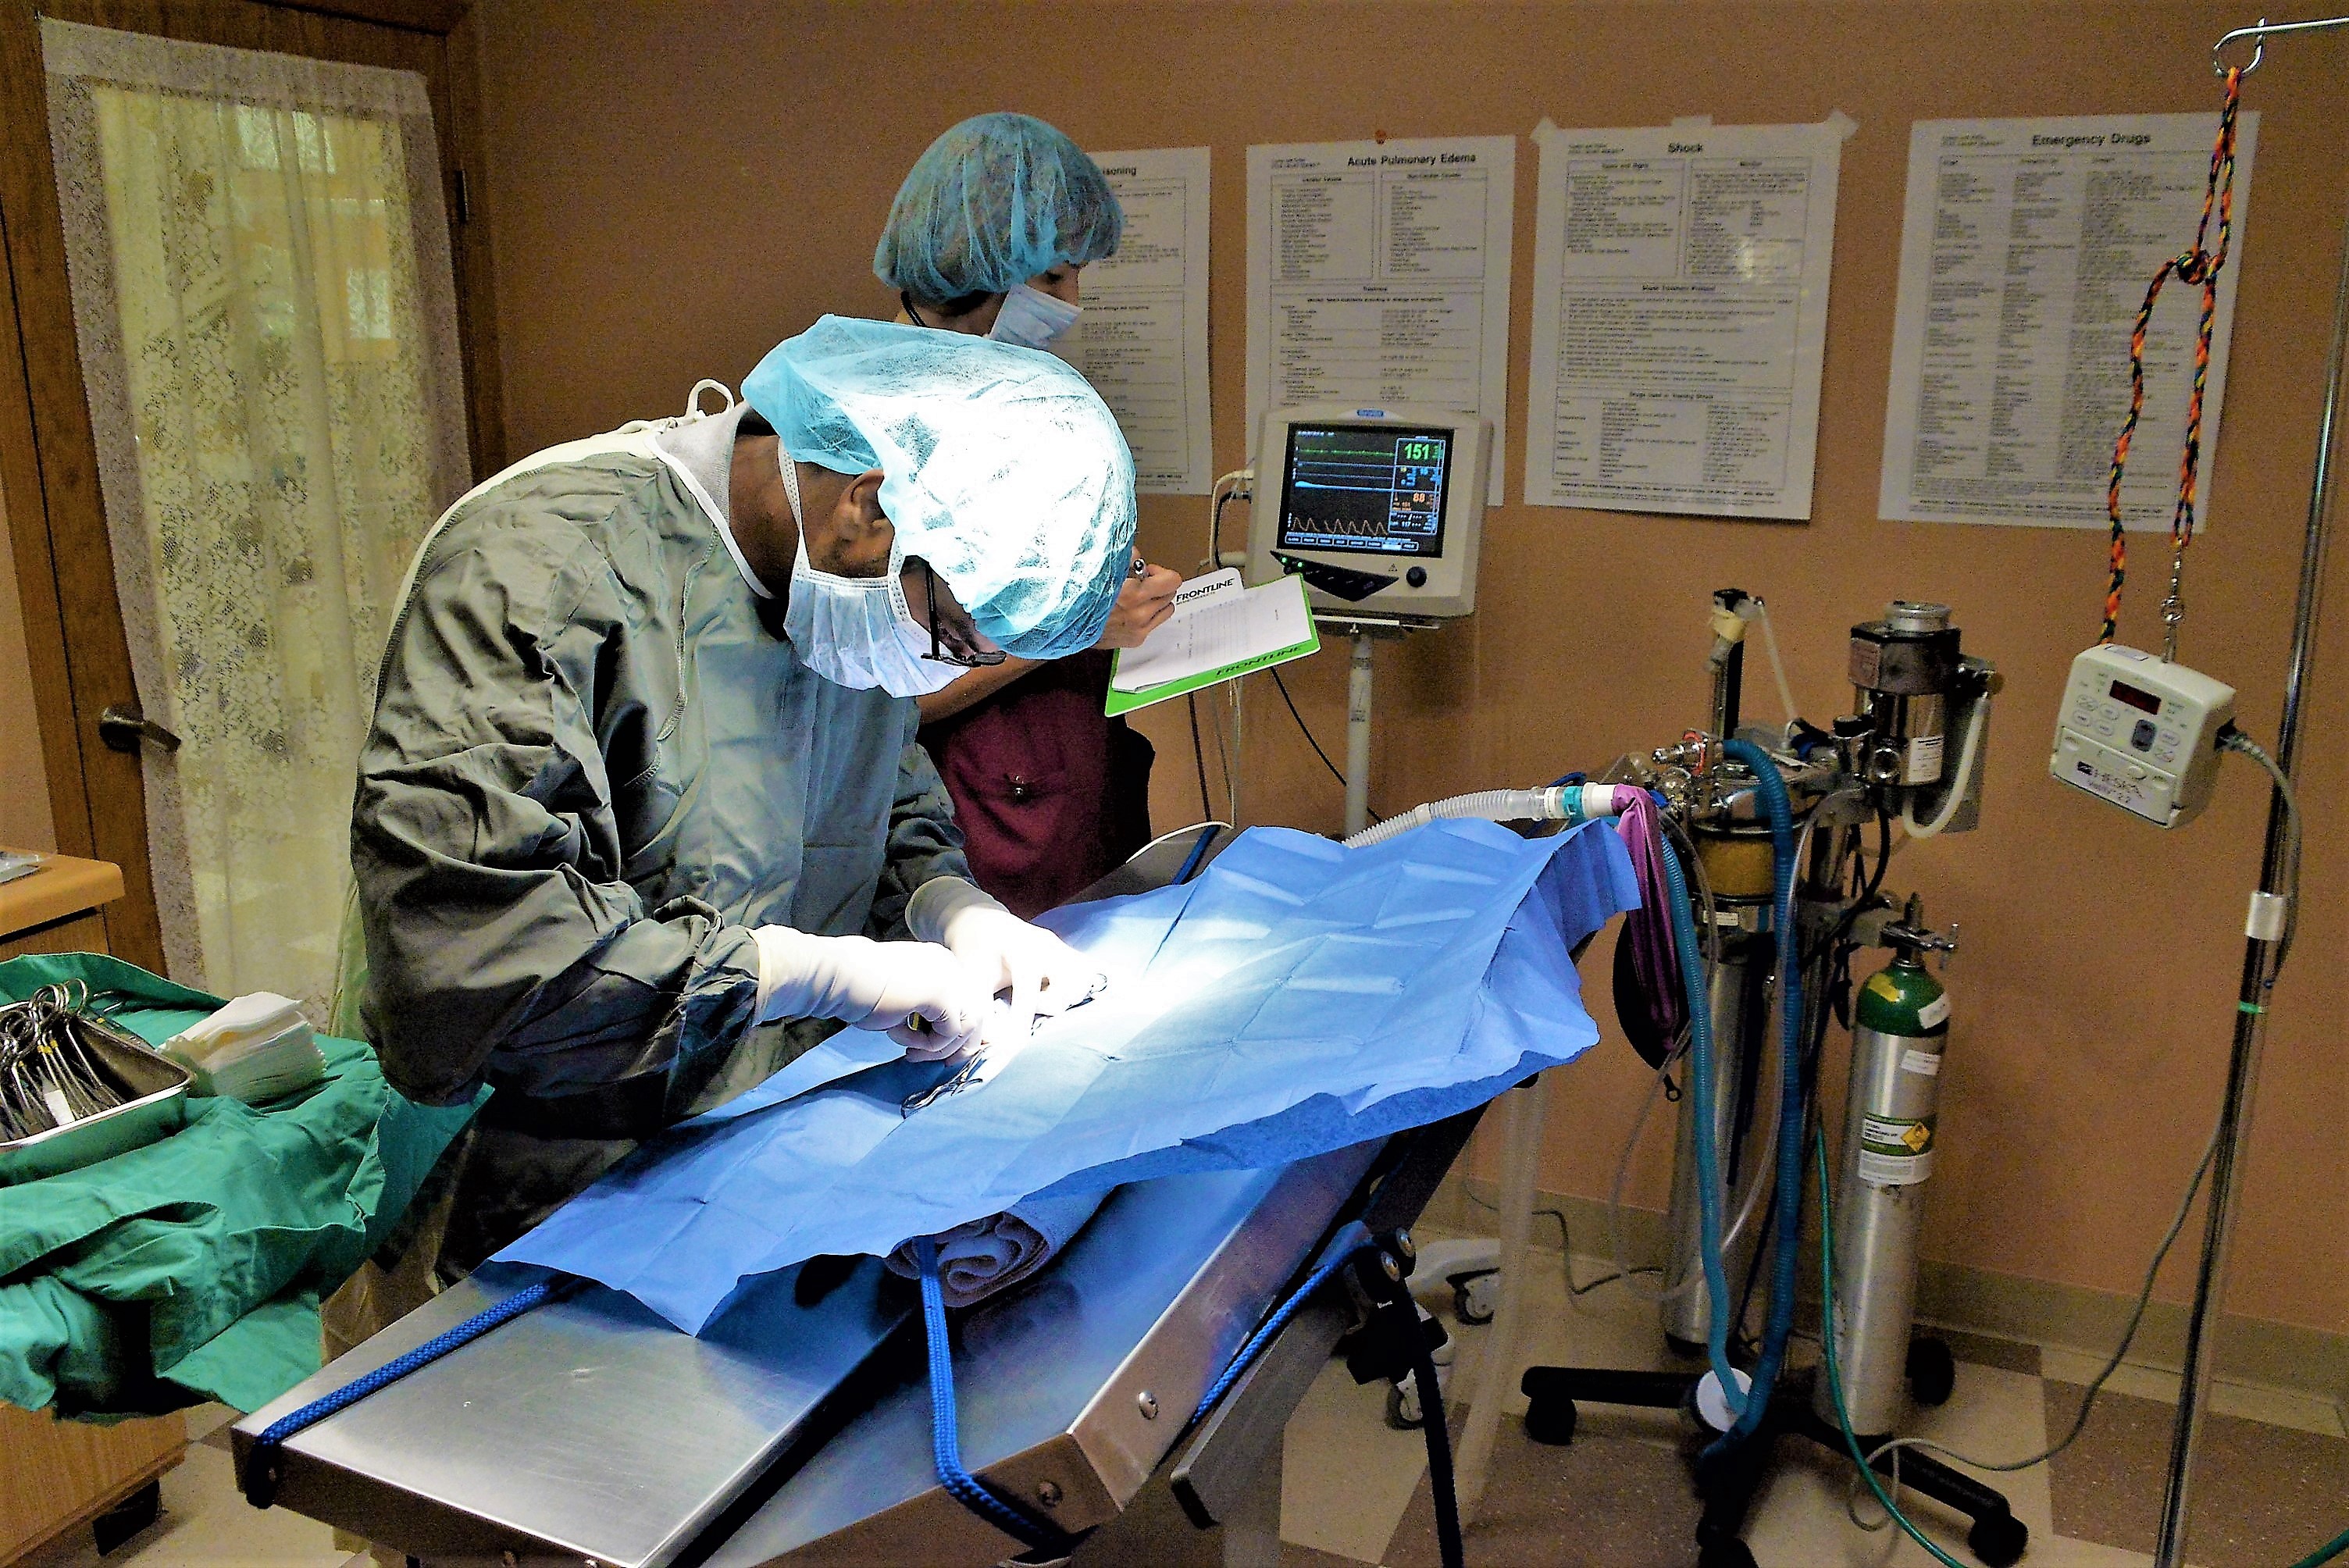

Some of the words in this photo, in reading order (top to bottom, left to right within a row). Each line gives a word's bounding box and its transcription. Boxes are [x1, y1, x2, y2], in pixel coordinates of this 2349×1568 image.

[2033, 134, 2105, 147] Emergency
[2112, 133, 2151, 146] Drugs
[1667, 142, 1703, 153] Shock
[1347, 156, 1377, 166] Acute
[1381, 155, 1436, 166] Pulmonary
[1441, 152, 1477, 163] Edema
[1102, 166, 1137, 176] isoning
[1404, 443, 1430, 460] 151
[1175, 578, 1235, 603] FRONTLINE
[1216, 646, 1301, 678] FRONTLINE
